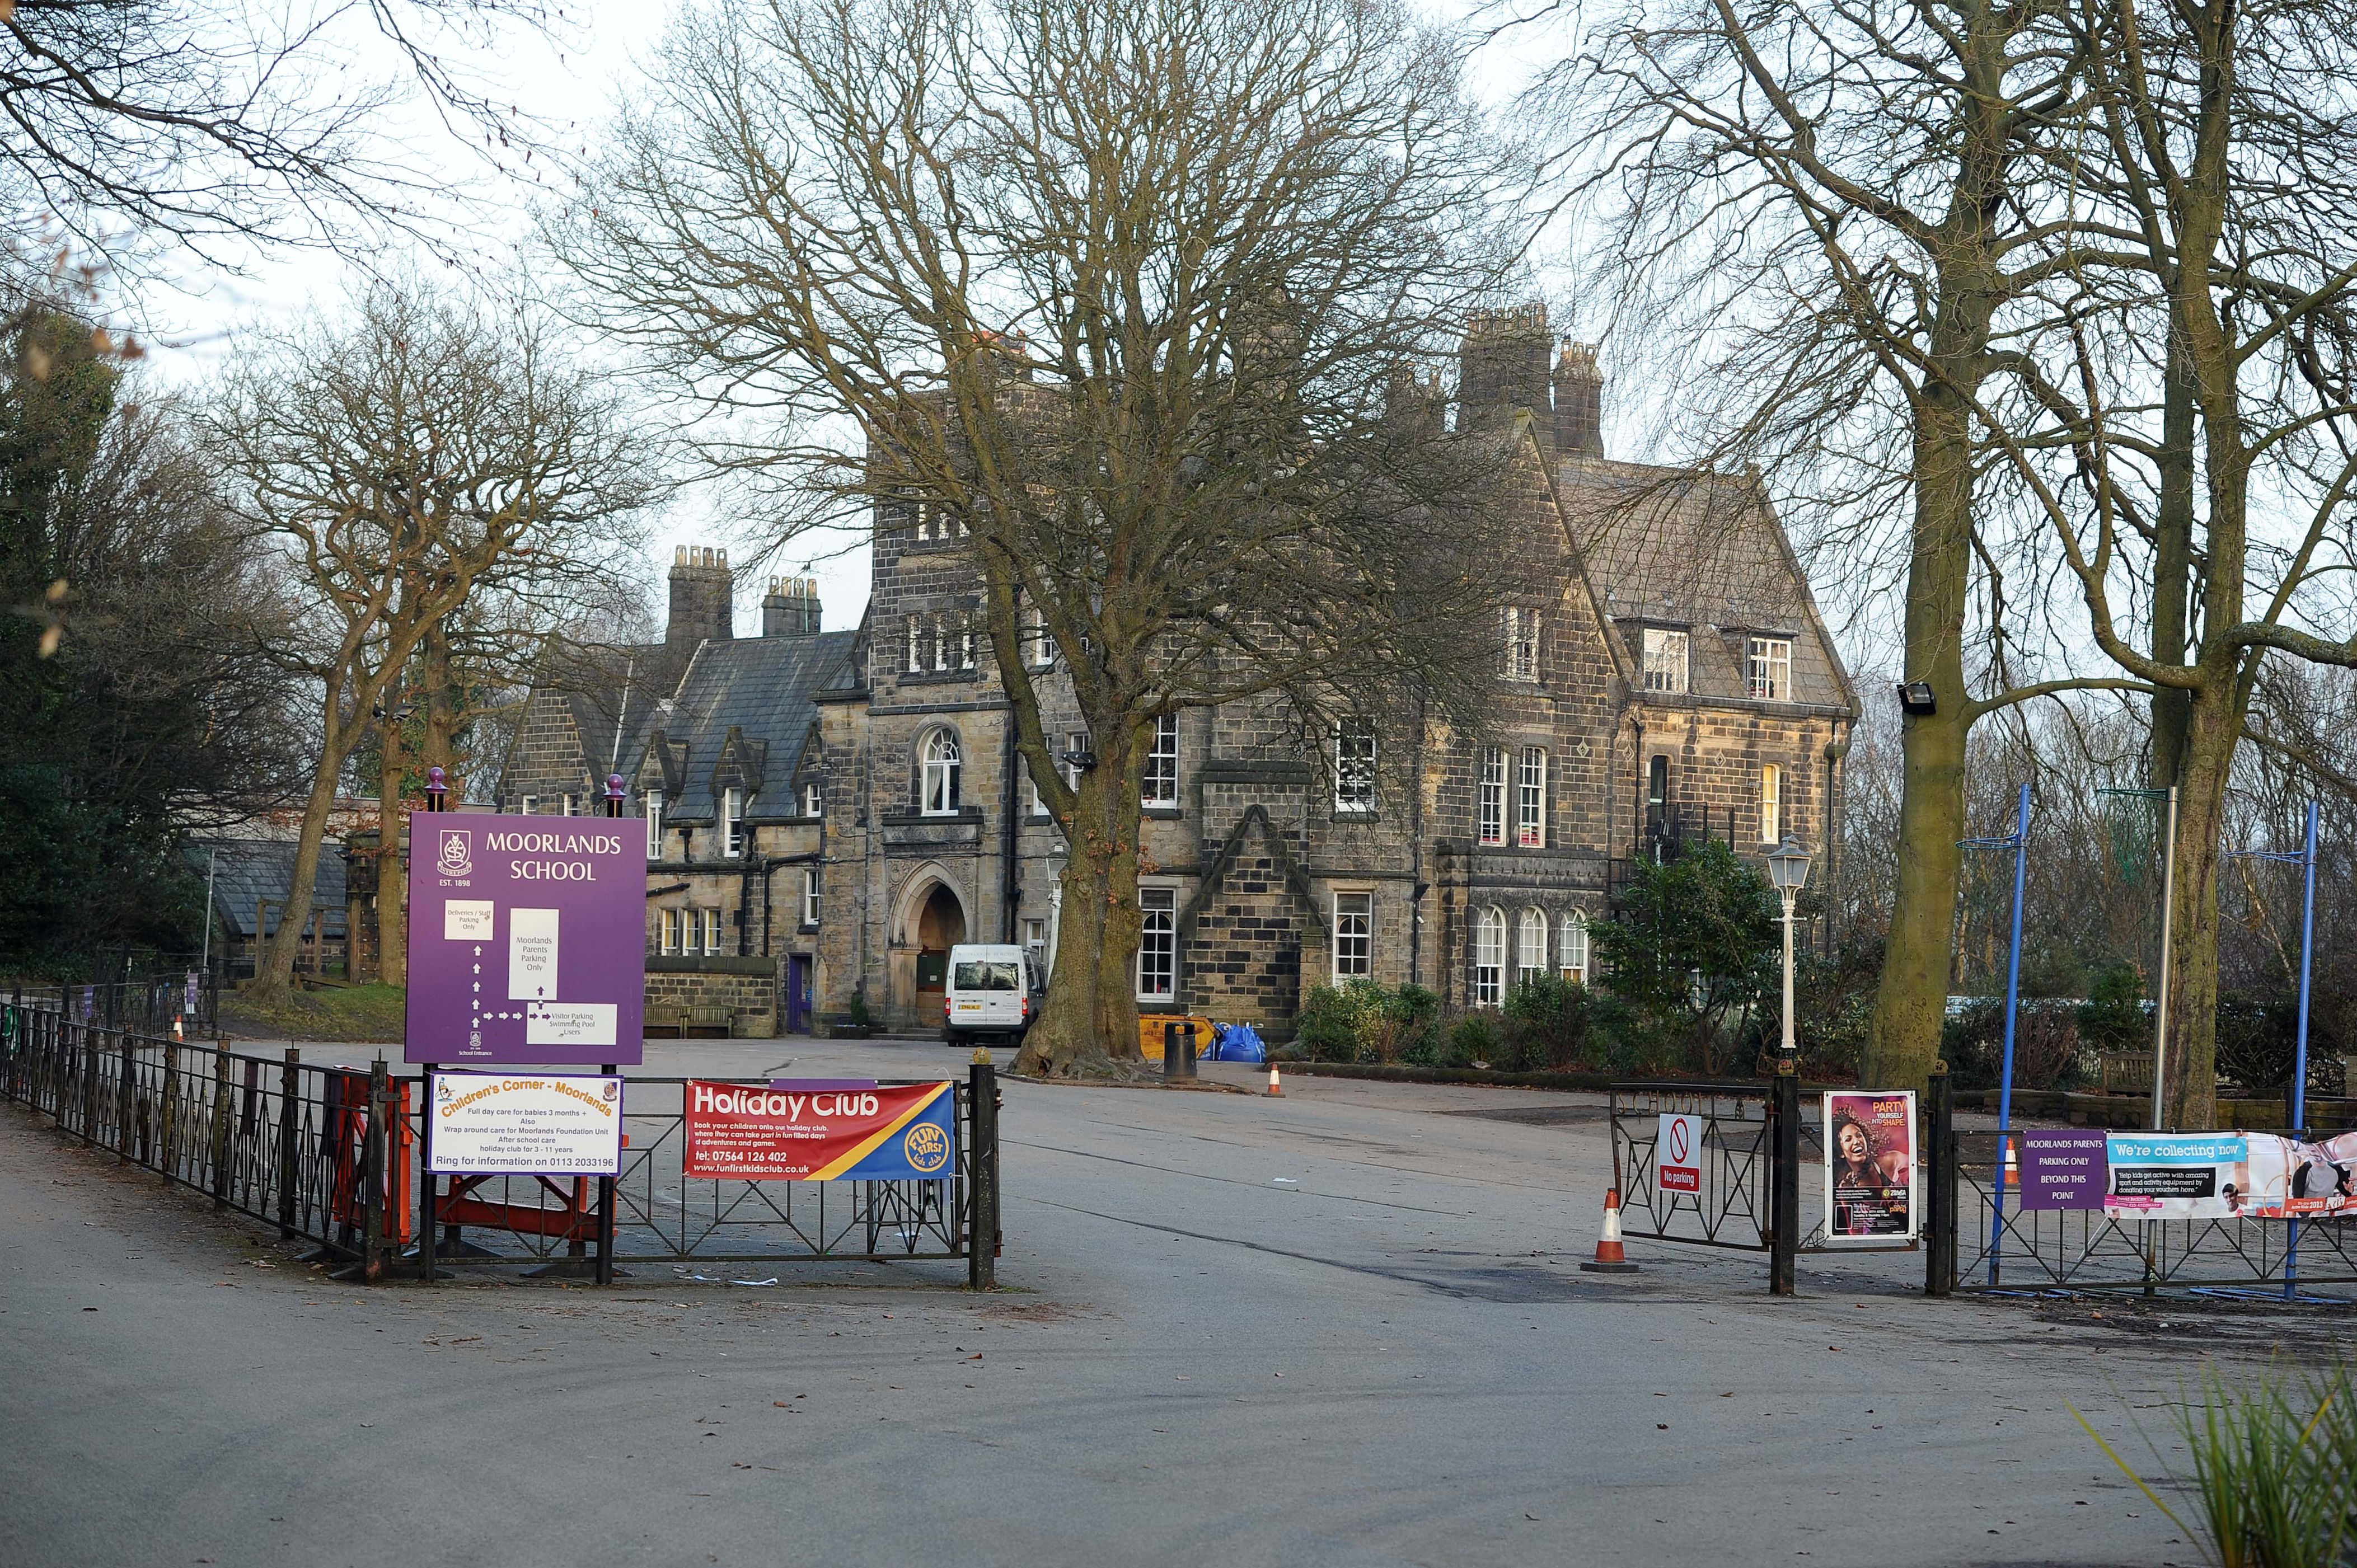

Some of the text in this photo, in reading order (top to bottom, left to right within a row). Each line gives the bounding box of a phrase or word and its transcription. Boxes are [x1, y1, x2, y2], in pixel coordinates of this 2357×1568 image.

[486, 832, 621, 855] MOORLANDS
[510, 860, 597, 881] SCHOOL
[441, 1085, 500, 1118] Children's
[503, 1080, 545, 1092] Corner
[555, 1081, 612, 1117] Moorlands
[694, 1086, 879, 1122] Holiday Club
[1873, 1101, 1906, 1112] PARTY
[909, 1128, 940, 1150] FUN
[480, 1145, 505, 1153] holiday
[917, 1142, 943, 1155] FIRST
[2115, 1144, 2238, 1158] We're collecting now
[436, 1156, 458, 1166] Ring
[461, 1156, 475, 1165] for
[477, 1157, 532, 1166] information
[575, 1158, 613, 1167] 2033196
[696, 1151, 787, 1162] tel: 07564 126 402
[913, 1153, 941, 1166] kids club
[693, 1164, 809, 1173] www.funfirstkidsclub.co.uk
[1664, 1170, 1695, 1187] No parking
[2041, 1175, 2086, 1184] BEYOND THIS
